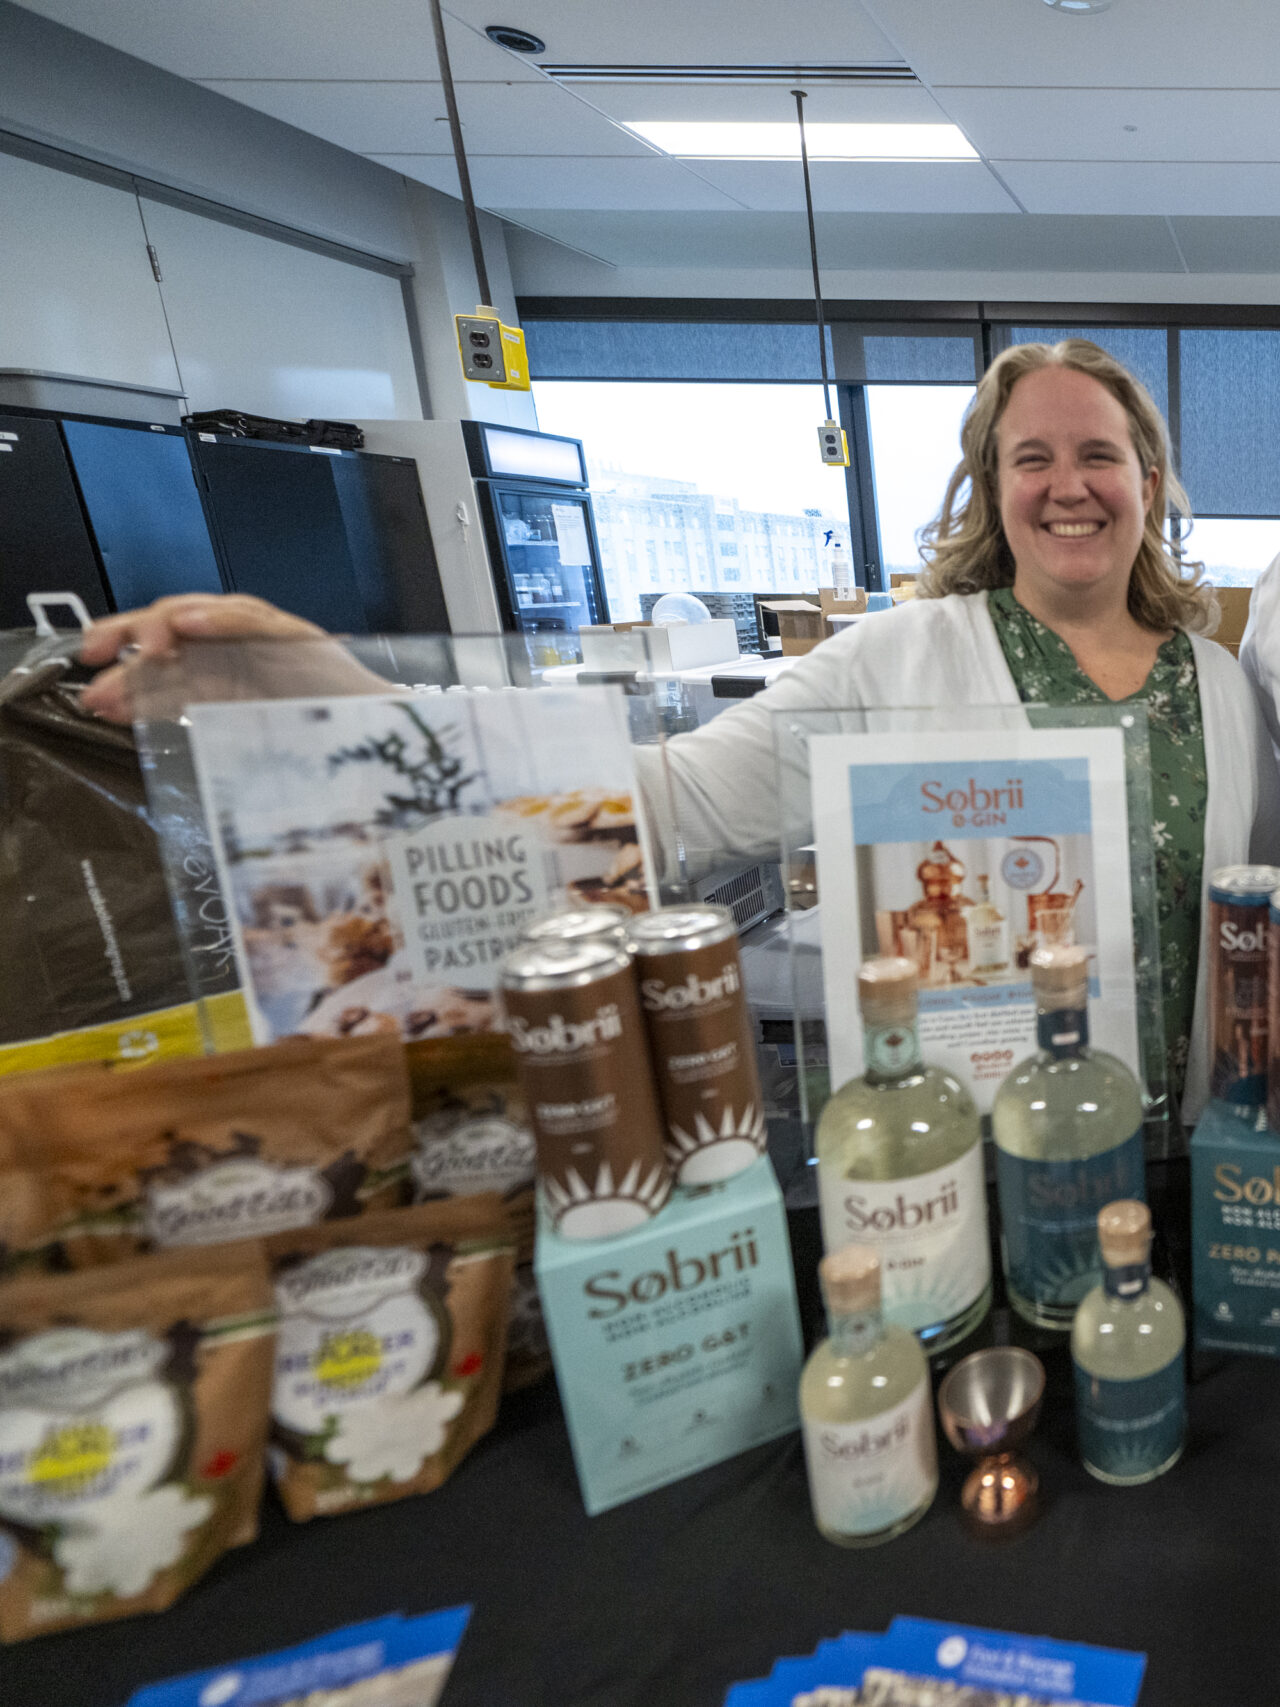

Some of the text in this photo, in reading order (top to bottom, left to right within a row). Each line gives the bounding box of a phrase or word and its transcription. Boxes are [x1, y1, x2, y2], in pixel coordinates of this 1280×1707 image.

[405, 834, 528, 876] PILLING
[413, 868, 533, 917] FOODS
[1209, 1243, 1262, 1263] ZERO
